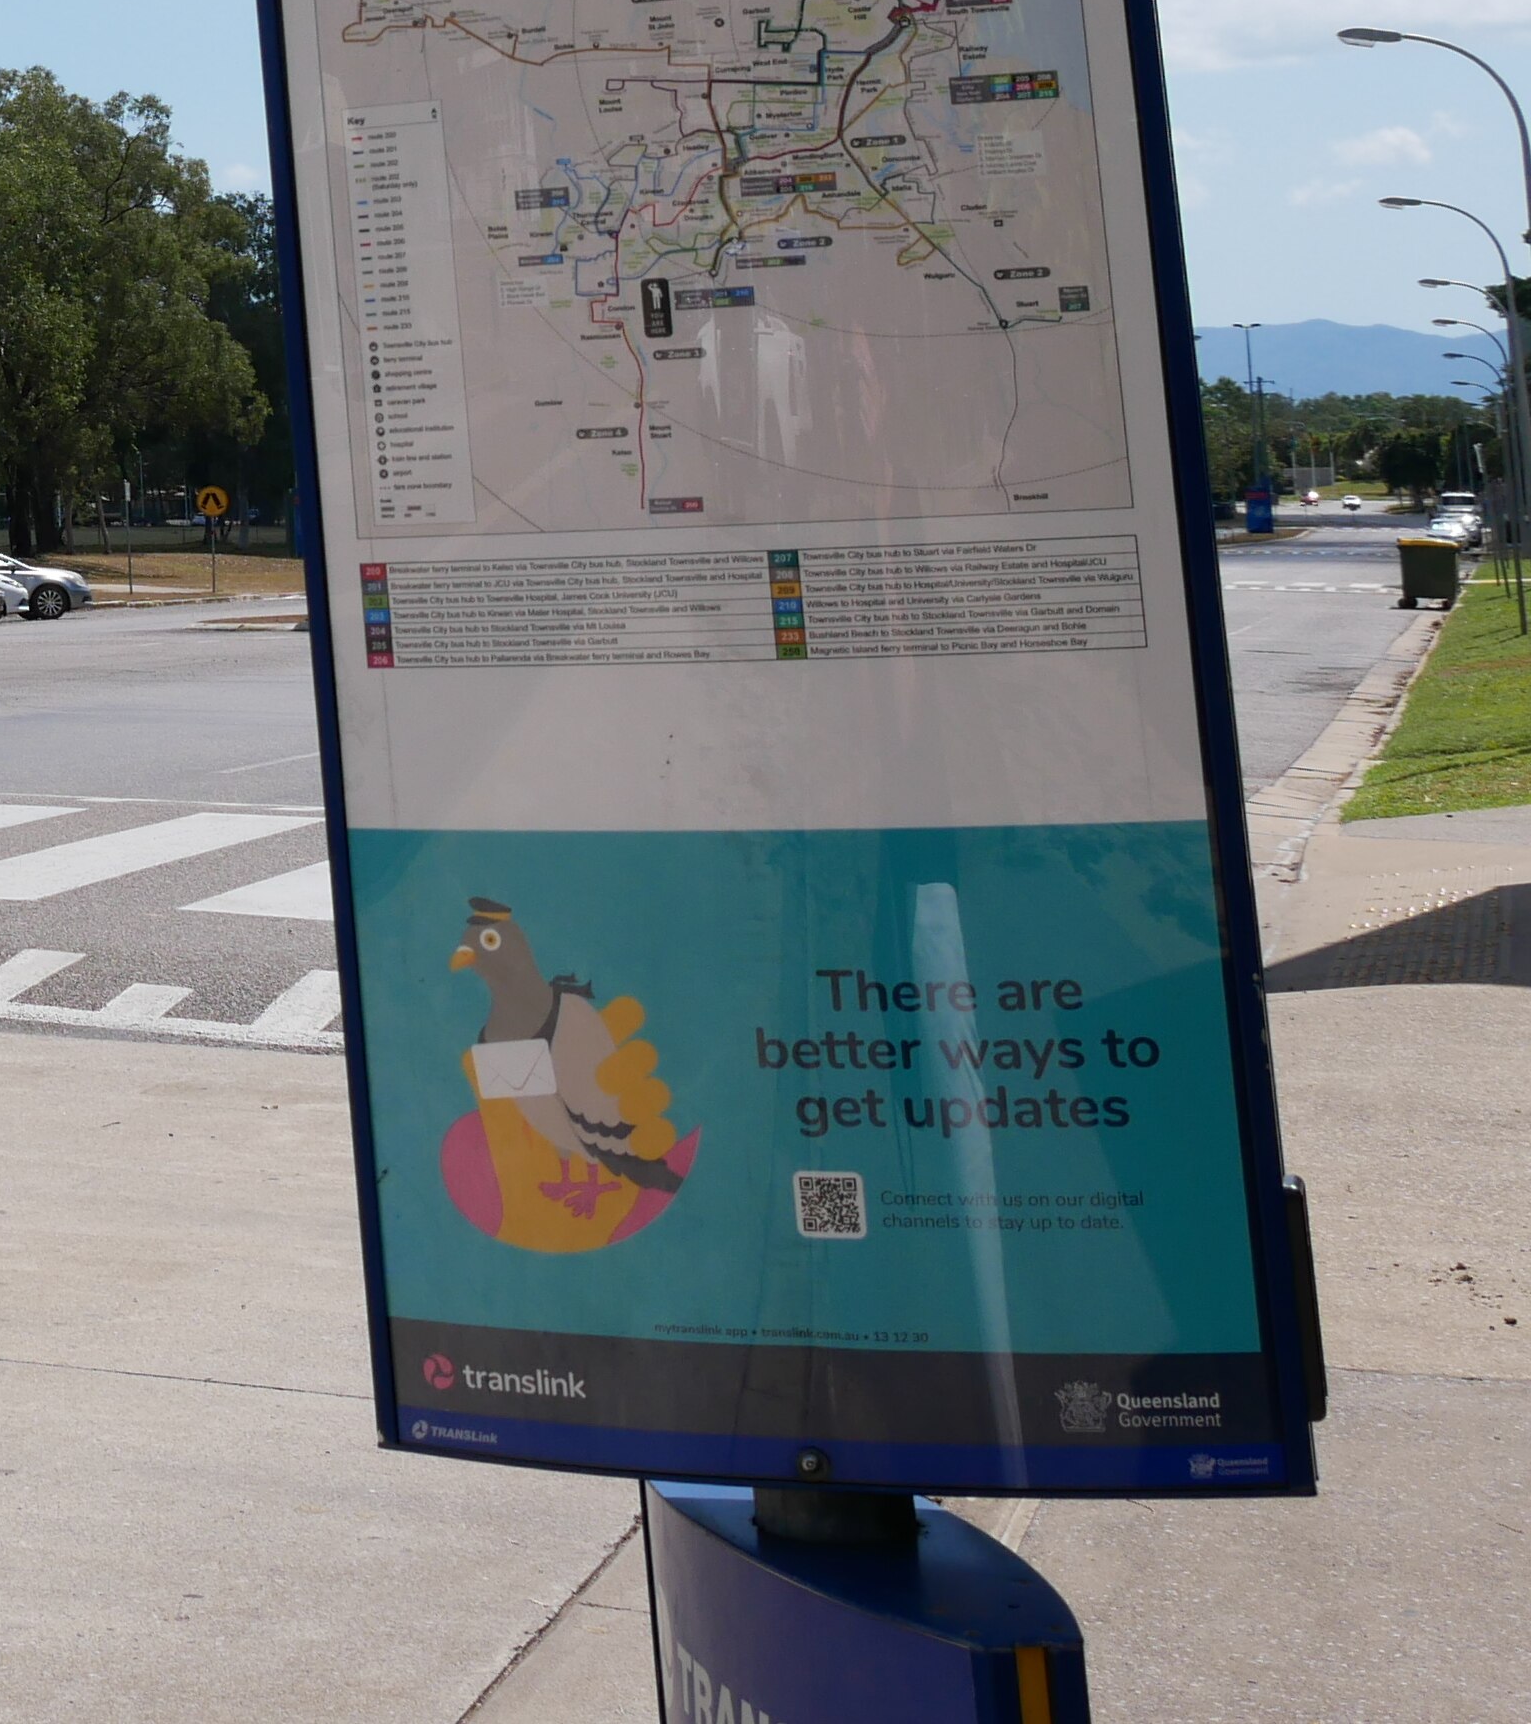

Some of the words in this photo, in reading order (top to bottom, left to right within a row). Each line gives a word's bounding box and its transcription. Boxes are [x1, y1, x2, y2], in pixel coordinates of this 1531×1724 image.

[347, 117, 365, 127] Key
[774, 554, 791, 563] 207
[779, 601, 796, 611] 210
[780, 617, 798, 626] 215
[816, 970, 979, 1013] There
[997, 978, 1084, 1012] are
[755, 1026, 922, 1070] better
[939, 1036, 1085, 1081] ways
[1102, 1029, 1161, 1069] to
[796, 1089, 887, 1139] get
[903, 1085, 1130, 1140] updates
[880, 1190, 954, 1207] Connect
[1002, 1195, 1023, 1207] us
[1028, 1195, 1050, 1207] on
[1055, 1195, 1084, 1207] our
[1090, 1191, 1144, 1210] digital
[883, 1213, 960, 1228] channels
[965, 1215, 982, 1228] to
[1030, 1218, 1052, 1232] up
[1058, 1216, 1075, 1228] to
[1079, 1214, 1124, 1229] date.
[654, 1323, 722, 1336] mytranslink
[725, 1326, 748, 1338] app
[760, 1327, 859, 1342] translink.com.au
[873, 1331, 889, 1342] 13
[893, 1331, 908, 1343] 12
[911, 1332, 929, 1343] 30
[462, 1364, 586, 1399] translink
[1116, 1392, 1220, 1410] Queensland
[1118, 1411, 1222, 1427] Government
[430, 1425, 499, 1444] TRANSLink
[1217, 1457, 1268, 1466] Queensland
